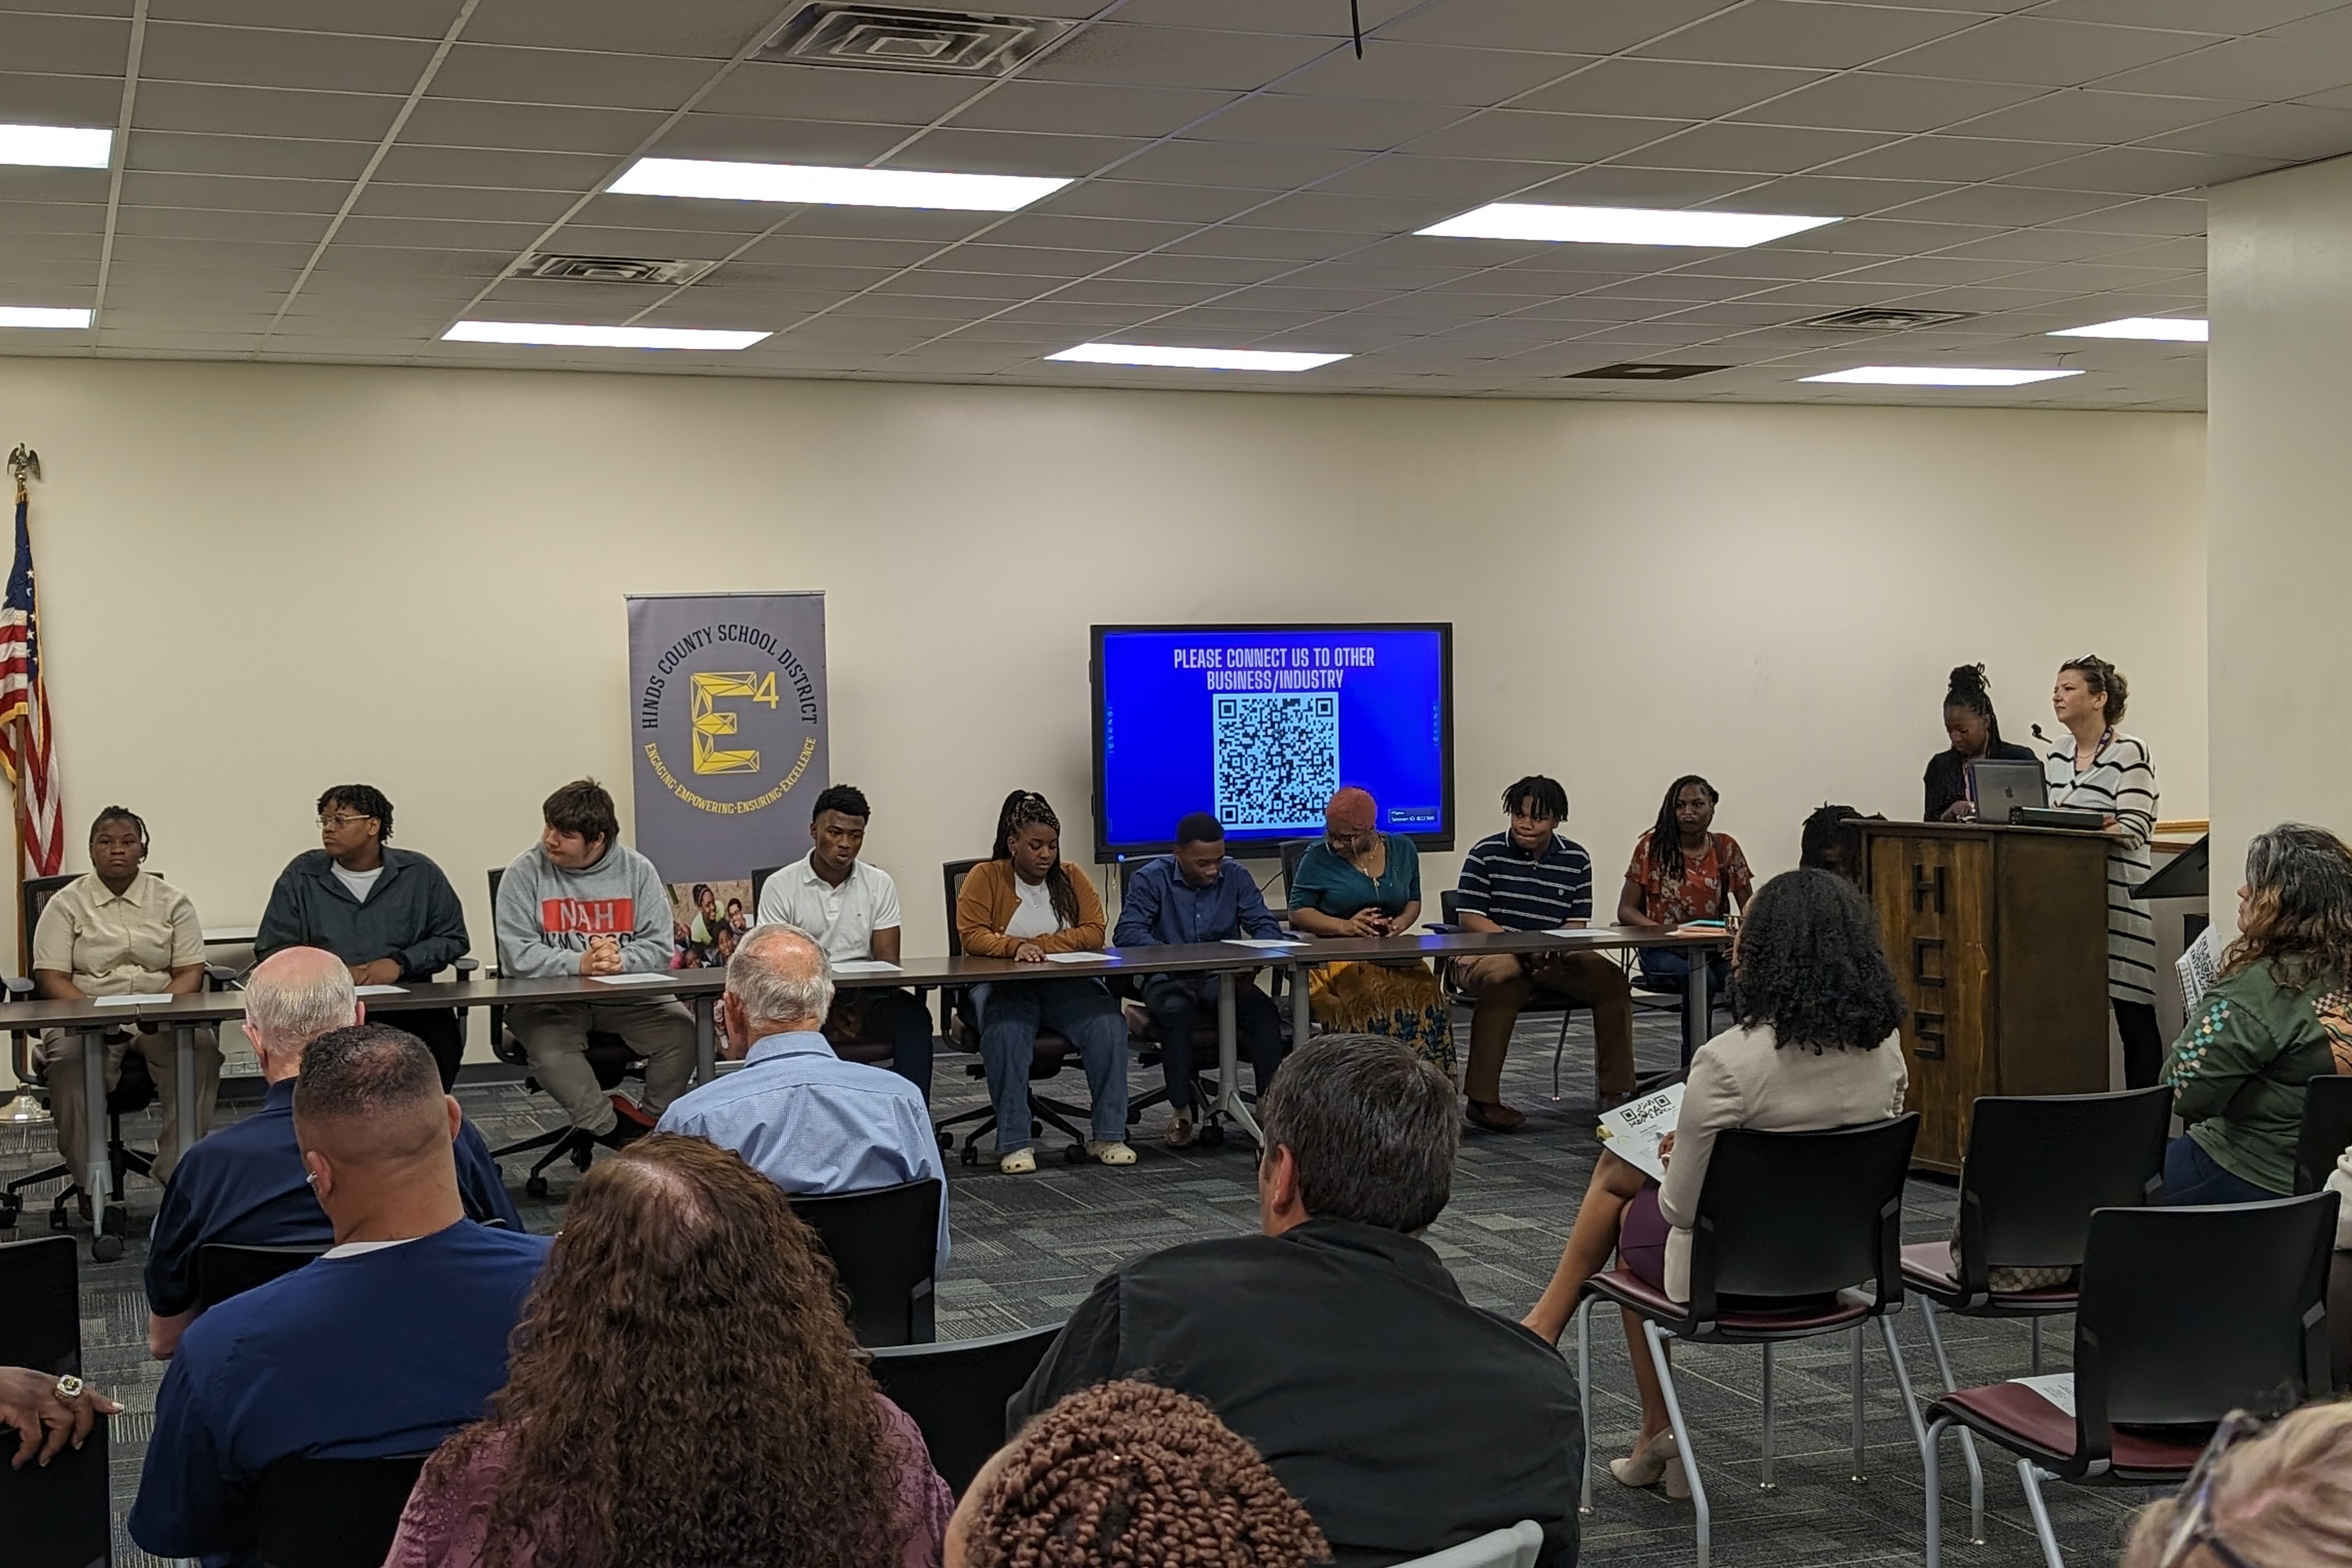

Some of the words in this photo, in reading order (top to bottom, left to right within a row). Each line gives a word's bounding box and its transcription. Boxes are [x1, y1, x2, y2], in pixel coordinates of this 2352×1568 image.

[1174, 648, 1223, 669] PLEASE
[1226, 647, 1287, 669] CONNECT
[1291, 647, 1309, 668] US
[1313, 647, 1330, 668] TO
[1334, 646, 1375, 667] OTHER
[642, 676, 665, 729] HINDS
[658, 626, 713, 675] COUNTY
[718, 624, 777, 656] SCHOOL
[777, 649, 817, 725] DISTRICT
[1207, 669, 1344, 693] BUSINESS/INDUSTRY
[560, 900, 615, 932] NAH
